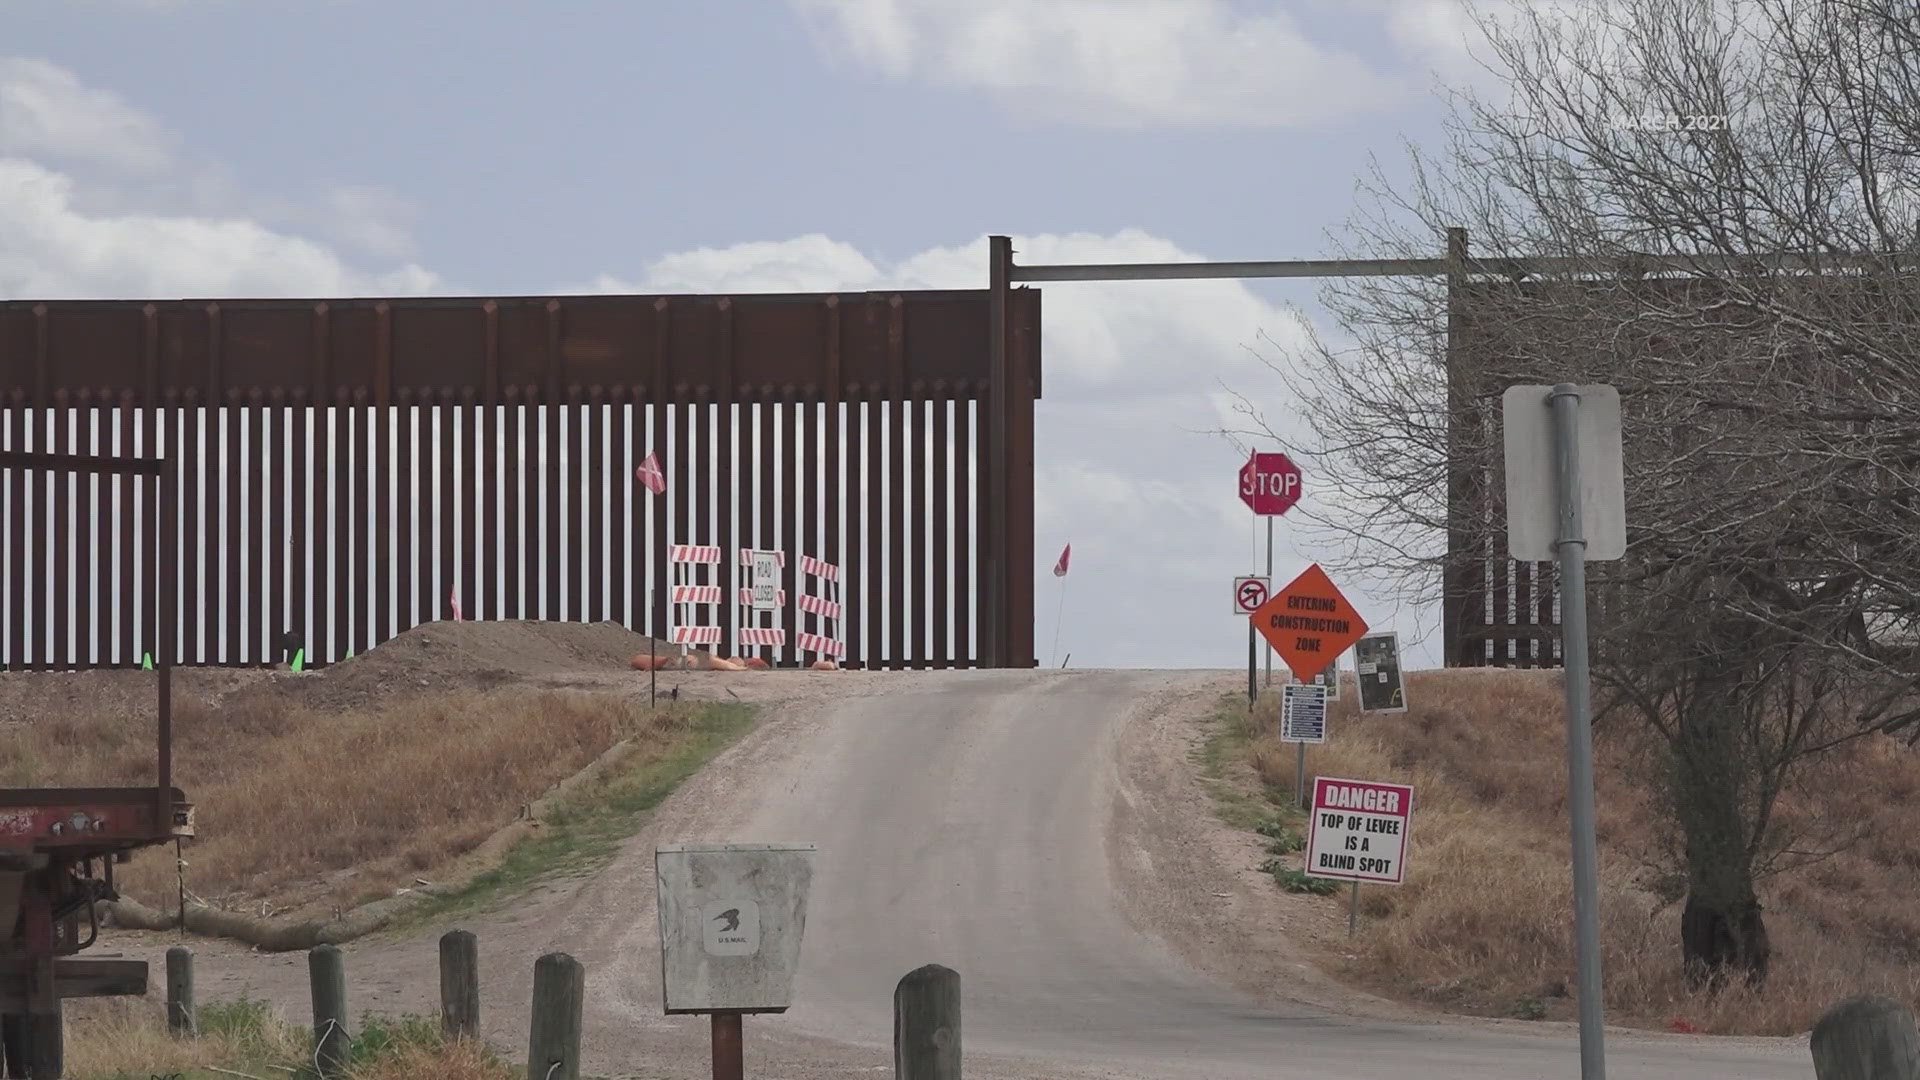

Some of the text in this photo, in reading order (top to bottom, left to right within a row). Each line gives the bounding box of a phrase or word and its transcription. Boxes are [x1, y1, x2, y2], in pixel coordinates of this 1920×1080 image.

[1242, 472, 1298, 496] STOP
[757, 561, 771, 577] ROAD
[755, 584, 773, 601] CLOSED
[1287, 595, 1336, 612] ENTERING
[1270, 614, 1350, 634] CONSTRUCTION
[1295, 637, 1321, 652] ZONE
[1324, 785, 1400, 813] DANGER
[1321, 813, 1400, 835] TOP OF LEVEE
[1345, 836, 1369, 852] IS A
[1320, 853, 1391, 874] BLIND SPOT
